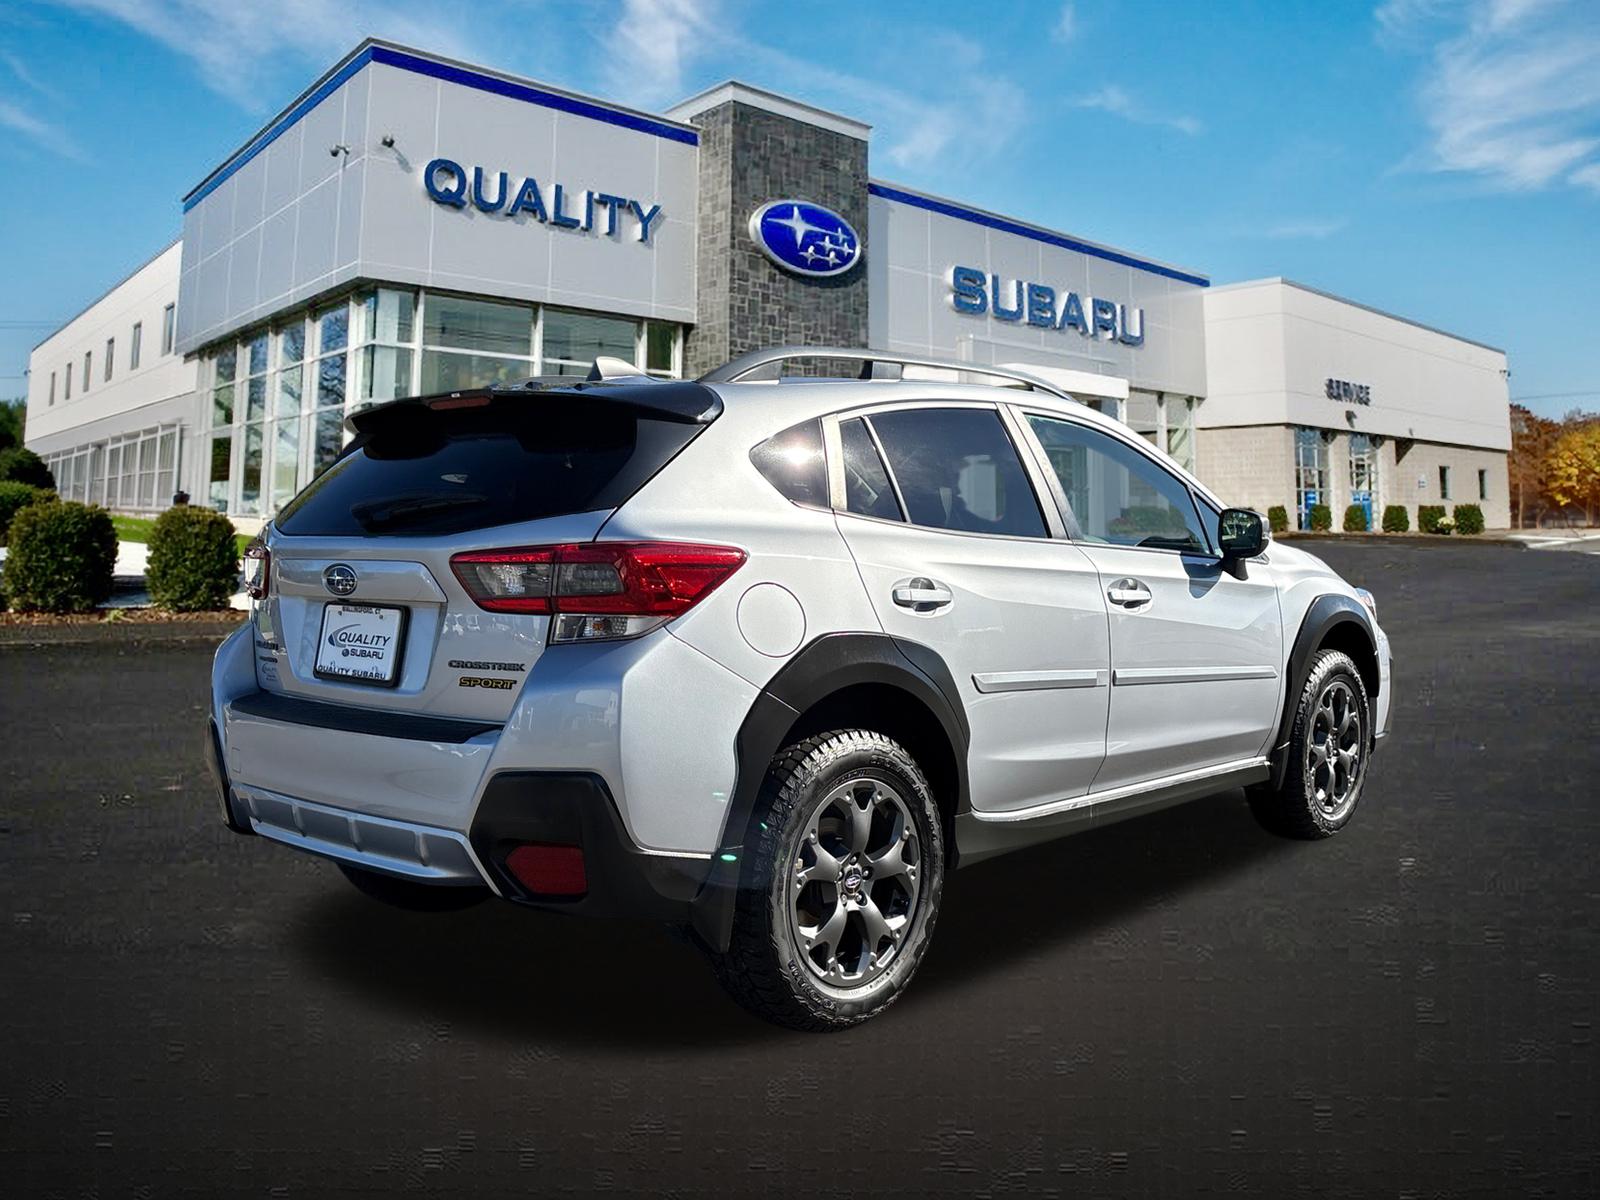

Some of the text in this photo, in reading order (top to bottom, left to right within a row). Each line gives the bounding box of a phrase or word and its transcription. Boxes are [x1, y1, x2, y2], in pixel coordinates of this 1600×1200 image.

[424, 158, 661, 243] QUALITY
[948, 265, 1145, 347] SUBARU
[1325, 378, 1371, 407] SERVICE
[338, 631, 391, 646] QUALITY
[350, 648, 384, 660] SUBARU
[317, 664, 386, 680] QUALITY SUBARU
[448, 659, 526, 672] CROSSTREK
[459, 676, 518, 690] SPORT
